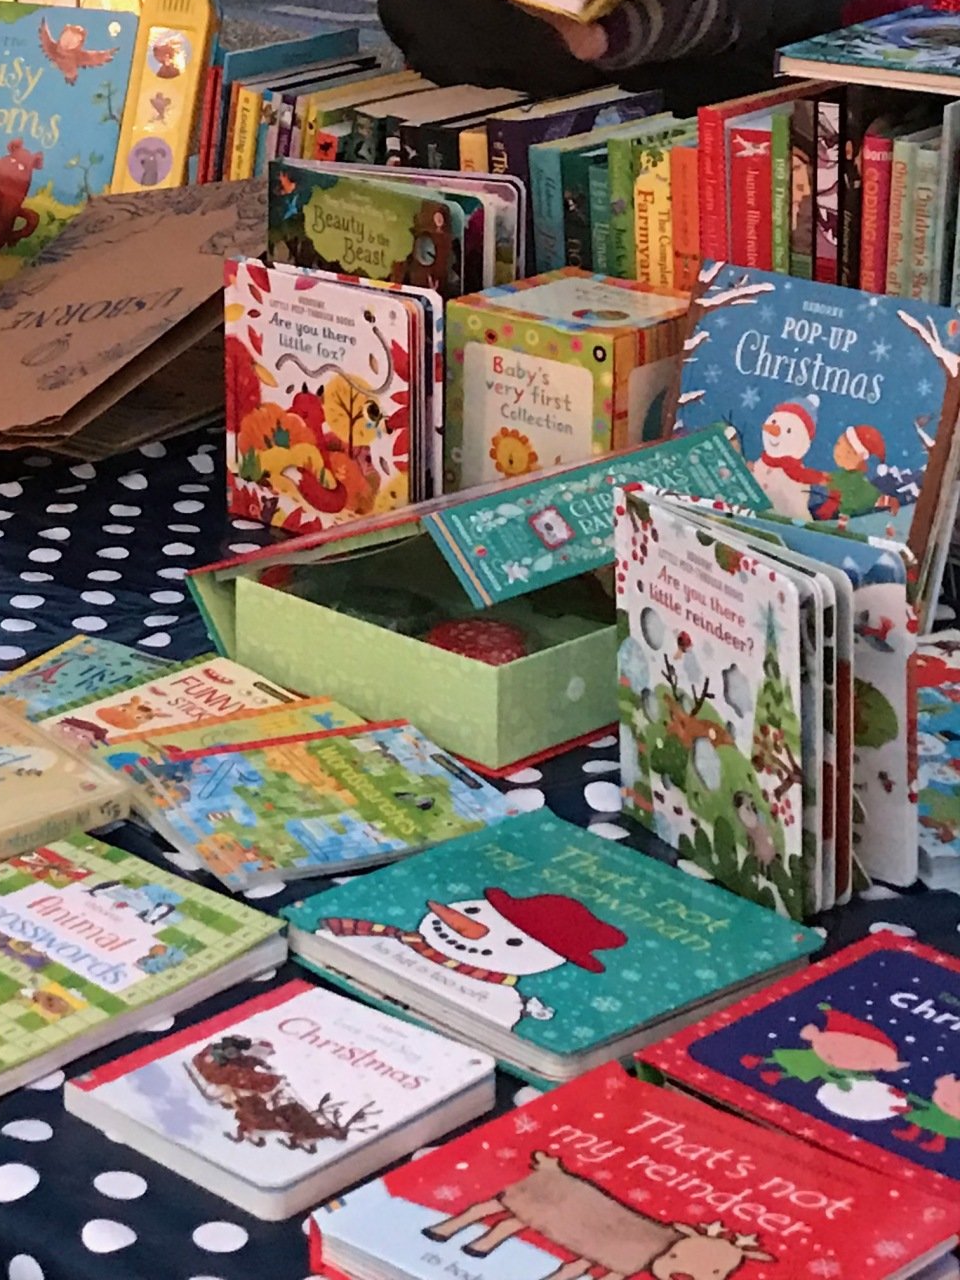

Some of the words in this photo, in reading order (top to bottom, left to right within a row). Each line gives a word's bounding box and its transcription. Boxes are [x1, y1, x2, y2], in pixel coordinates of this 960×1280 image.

[705, 178, 717, 211] Learn
[746, 167, 760, 206] Junior
[864, 167, 880, 242] CODING
[891, 161, 908, 228] Children's
[312, 205, 365, 243] Beauty
[658, 209, 670, 233] The
[774, 187, 785, 226] Things
[637, 188, 655, 283] Farmyar
[775, 228, 782, 243] on
[912, 187, 933, 267] Children's
[342, 236, 388, 269] Beast
[657, 235, 670, 286] Complet
[890, 232, 903, 266] Book
[889, 271, 901, 287] of
[0, 286, 183, 331] USBORNE
[268, 312, 292, 330] Are
[295, 322, 319, 338] you
[322, 327, 357, 346] there
[279, 333, 313, 354] little
[317, 341, 346, 362] fox?
[781, 316, 859, 353] POP-UP
[493, 355, 550, 387] Baby's
[735, 329, 885, 404] Christmas
[486, 380, 525, 404] very
[530, 384, 573, 413] first
[500, 403, 574, 436] Collection
[657, 565, 681, 590] Are
[683, 584, 706, 607] you
[710, 596, 746, 628] there
[649, 582, 682, 616] little
[685, 608, 754, 657] reindeer?
[167, 697, 212, 721] STICK
[26, 895, 137, 952] Animal
[655, 898, 733, 934] not
[278, 1017, 430, 1091] Christmas
[548, 1123, 626, 1164] my
[626, 1153, 814, 1237] reindeer
[626, 1111, 757, 1179] That's
[759, 1175, 855, 1220] not
